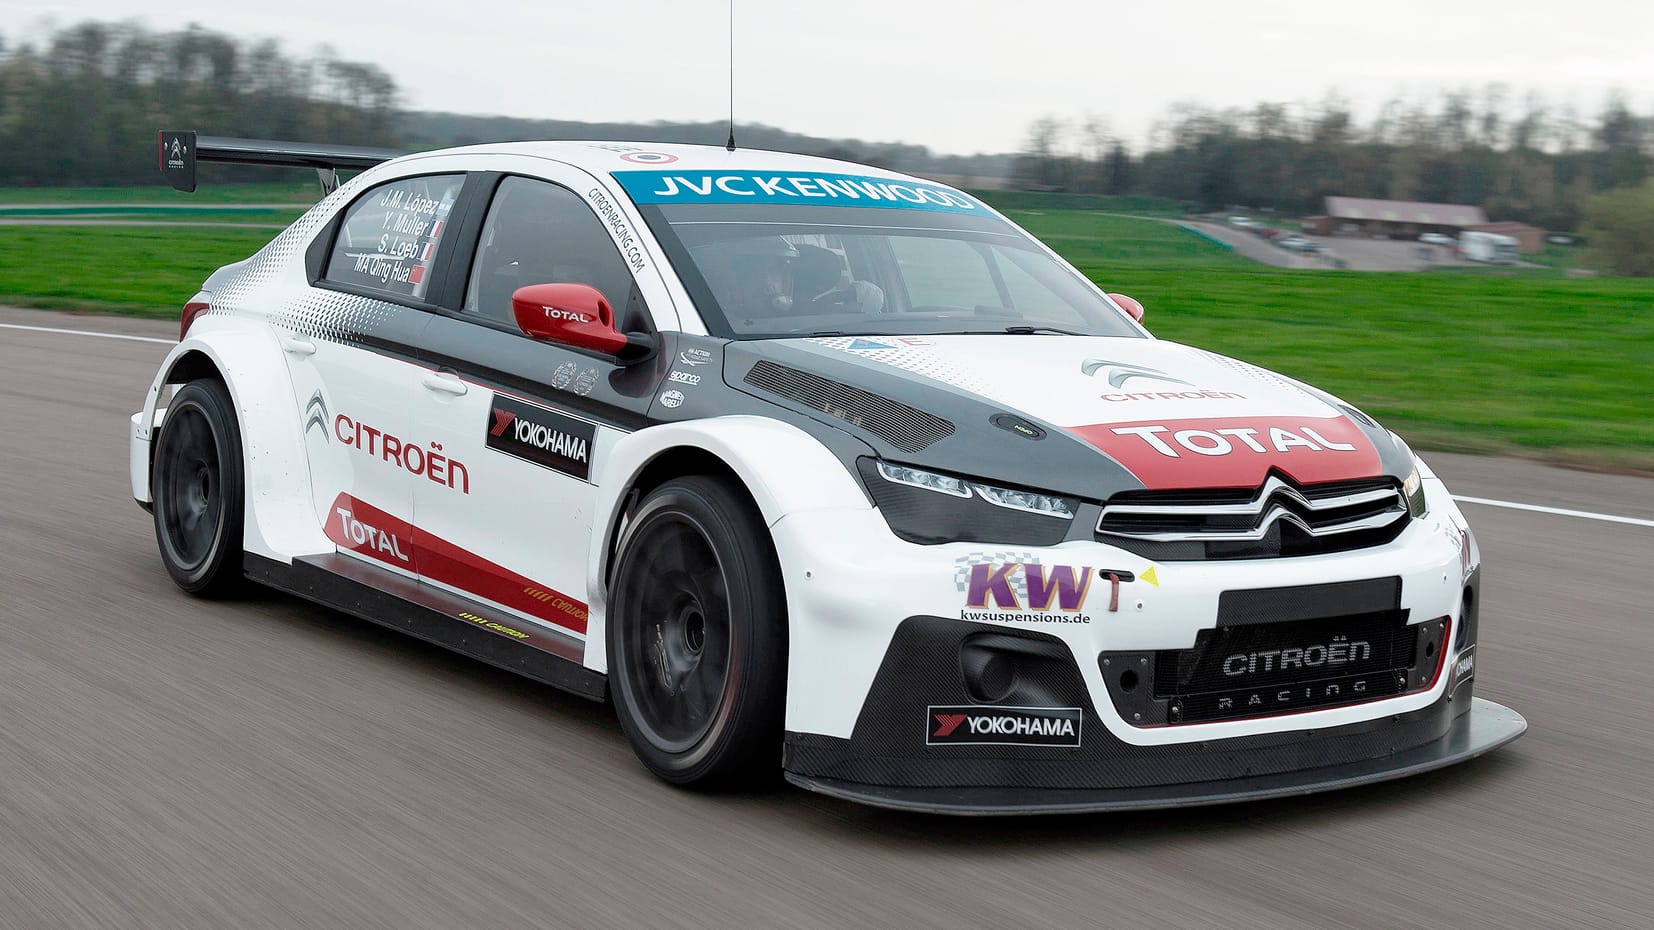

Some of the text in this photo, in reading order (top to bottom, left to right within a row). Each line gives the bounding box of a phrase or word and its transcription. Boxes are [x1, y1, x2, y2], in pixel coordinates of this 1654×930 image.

[380, 189, 440, 216] J.M. López
[382, 211, 430, 237] Y. Muller
[588, 188, 646, 274] CITROENRACING.COM
[378, 233, 419, 259] S. Loeb
[370, 257, 392, 283] Qing
[391, 261, 411, 283] Hua
[542, 305, 589, 323] TOTAL
[670, 370, 701, 383] sparco
[513, 416, 588, 464] YOKOHAMA
[1109, 424, 1358, 459] TOTAL
[336, 506, 409, 562] TOTAL
[965, 563, 1096, 612] KW
[960, 609, 1091, 624] kwsuspensions.de
[1218, 681, 1367, 710] RACING
[967, 716, 1076, 737] YOKOHAMA
